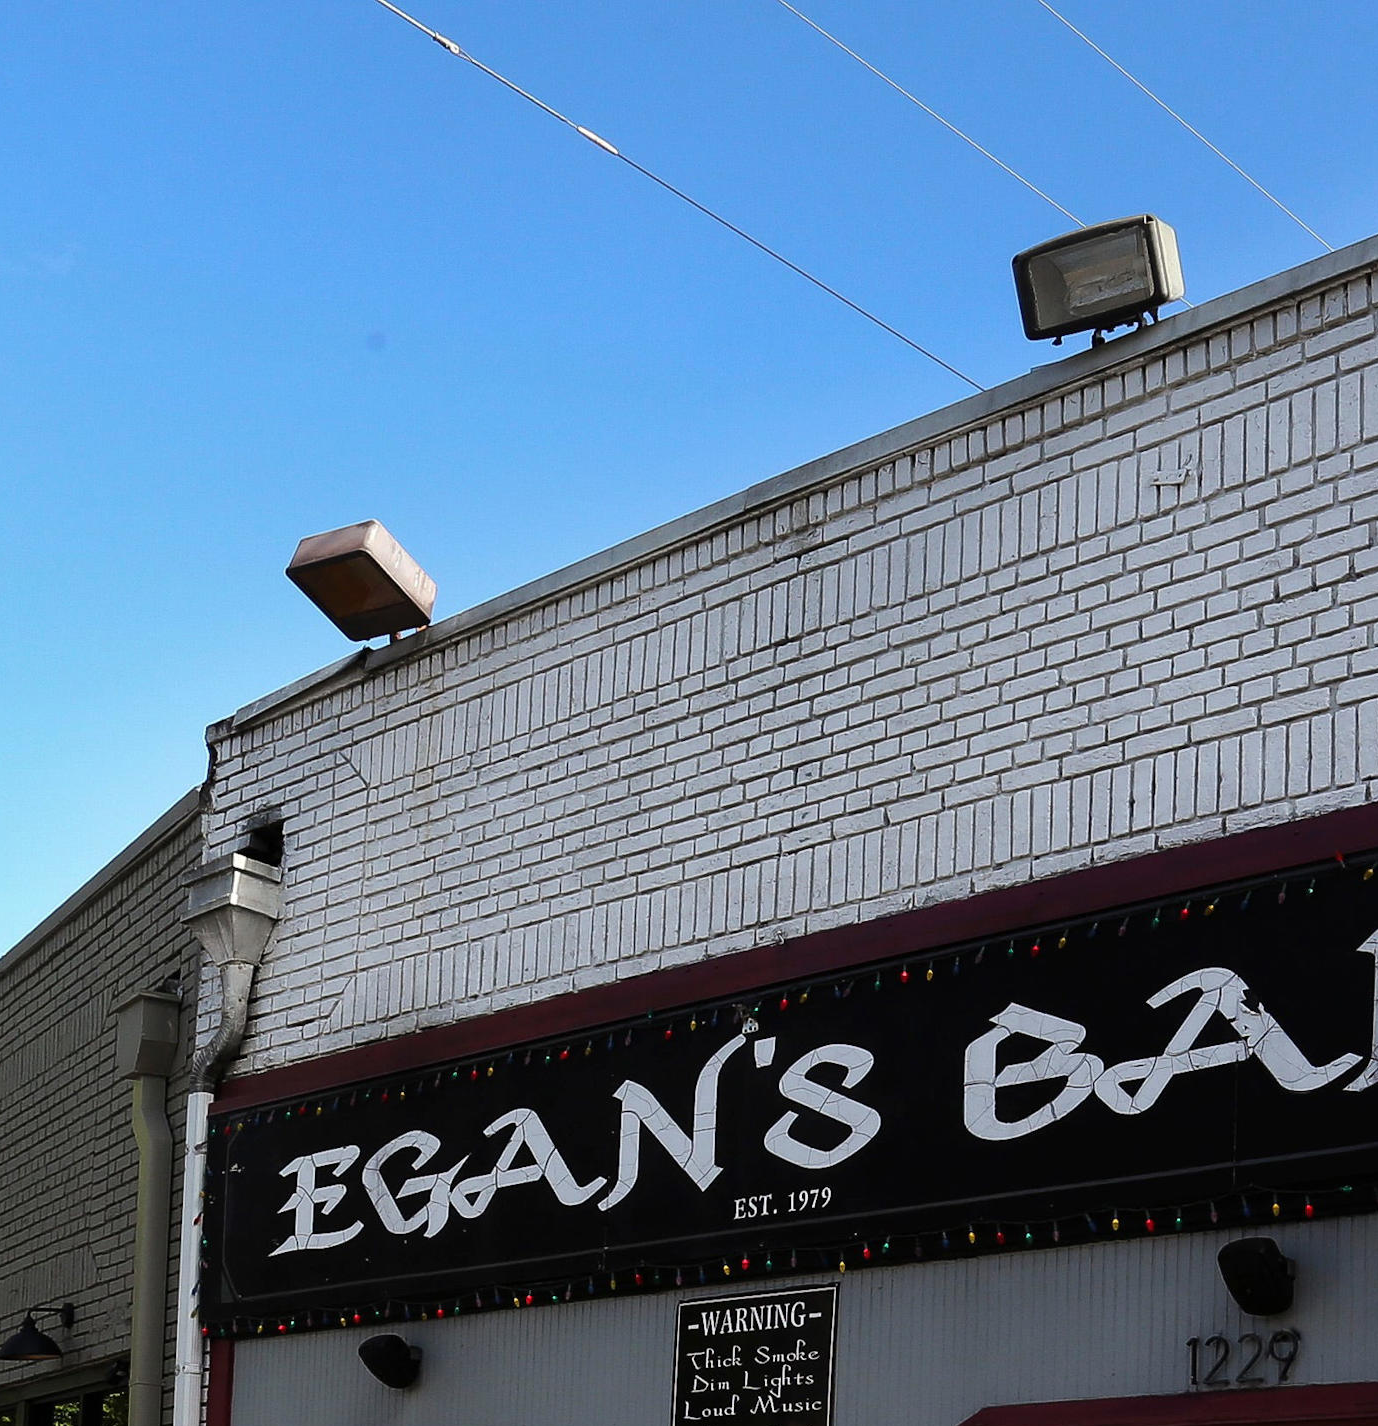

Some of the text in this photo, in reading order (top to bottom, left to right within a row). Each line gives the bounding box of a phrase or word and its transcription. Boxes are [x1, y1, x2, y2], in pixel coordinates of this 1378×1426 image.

[268, 1033, 882, 1257] EGAN'S
[733, 1186, 832, 1220] EST. 1979
[686, 1339, 820, 1370] Thick Smoke
[1185, 1328, 1301, 1385] 1229
[691, 1364, 815, 1398] Dim Lights
[684, 1394, 822, 1420] Loud Music
